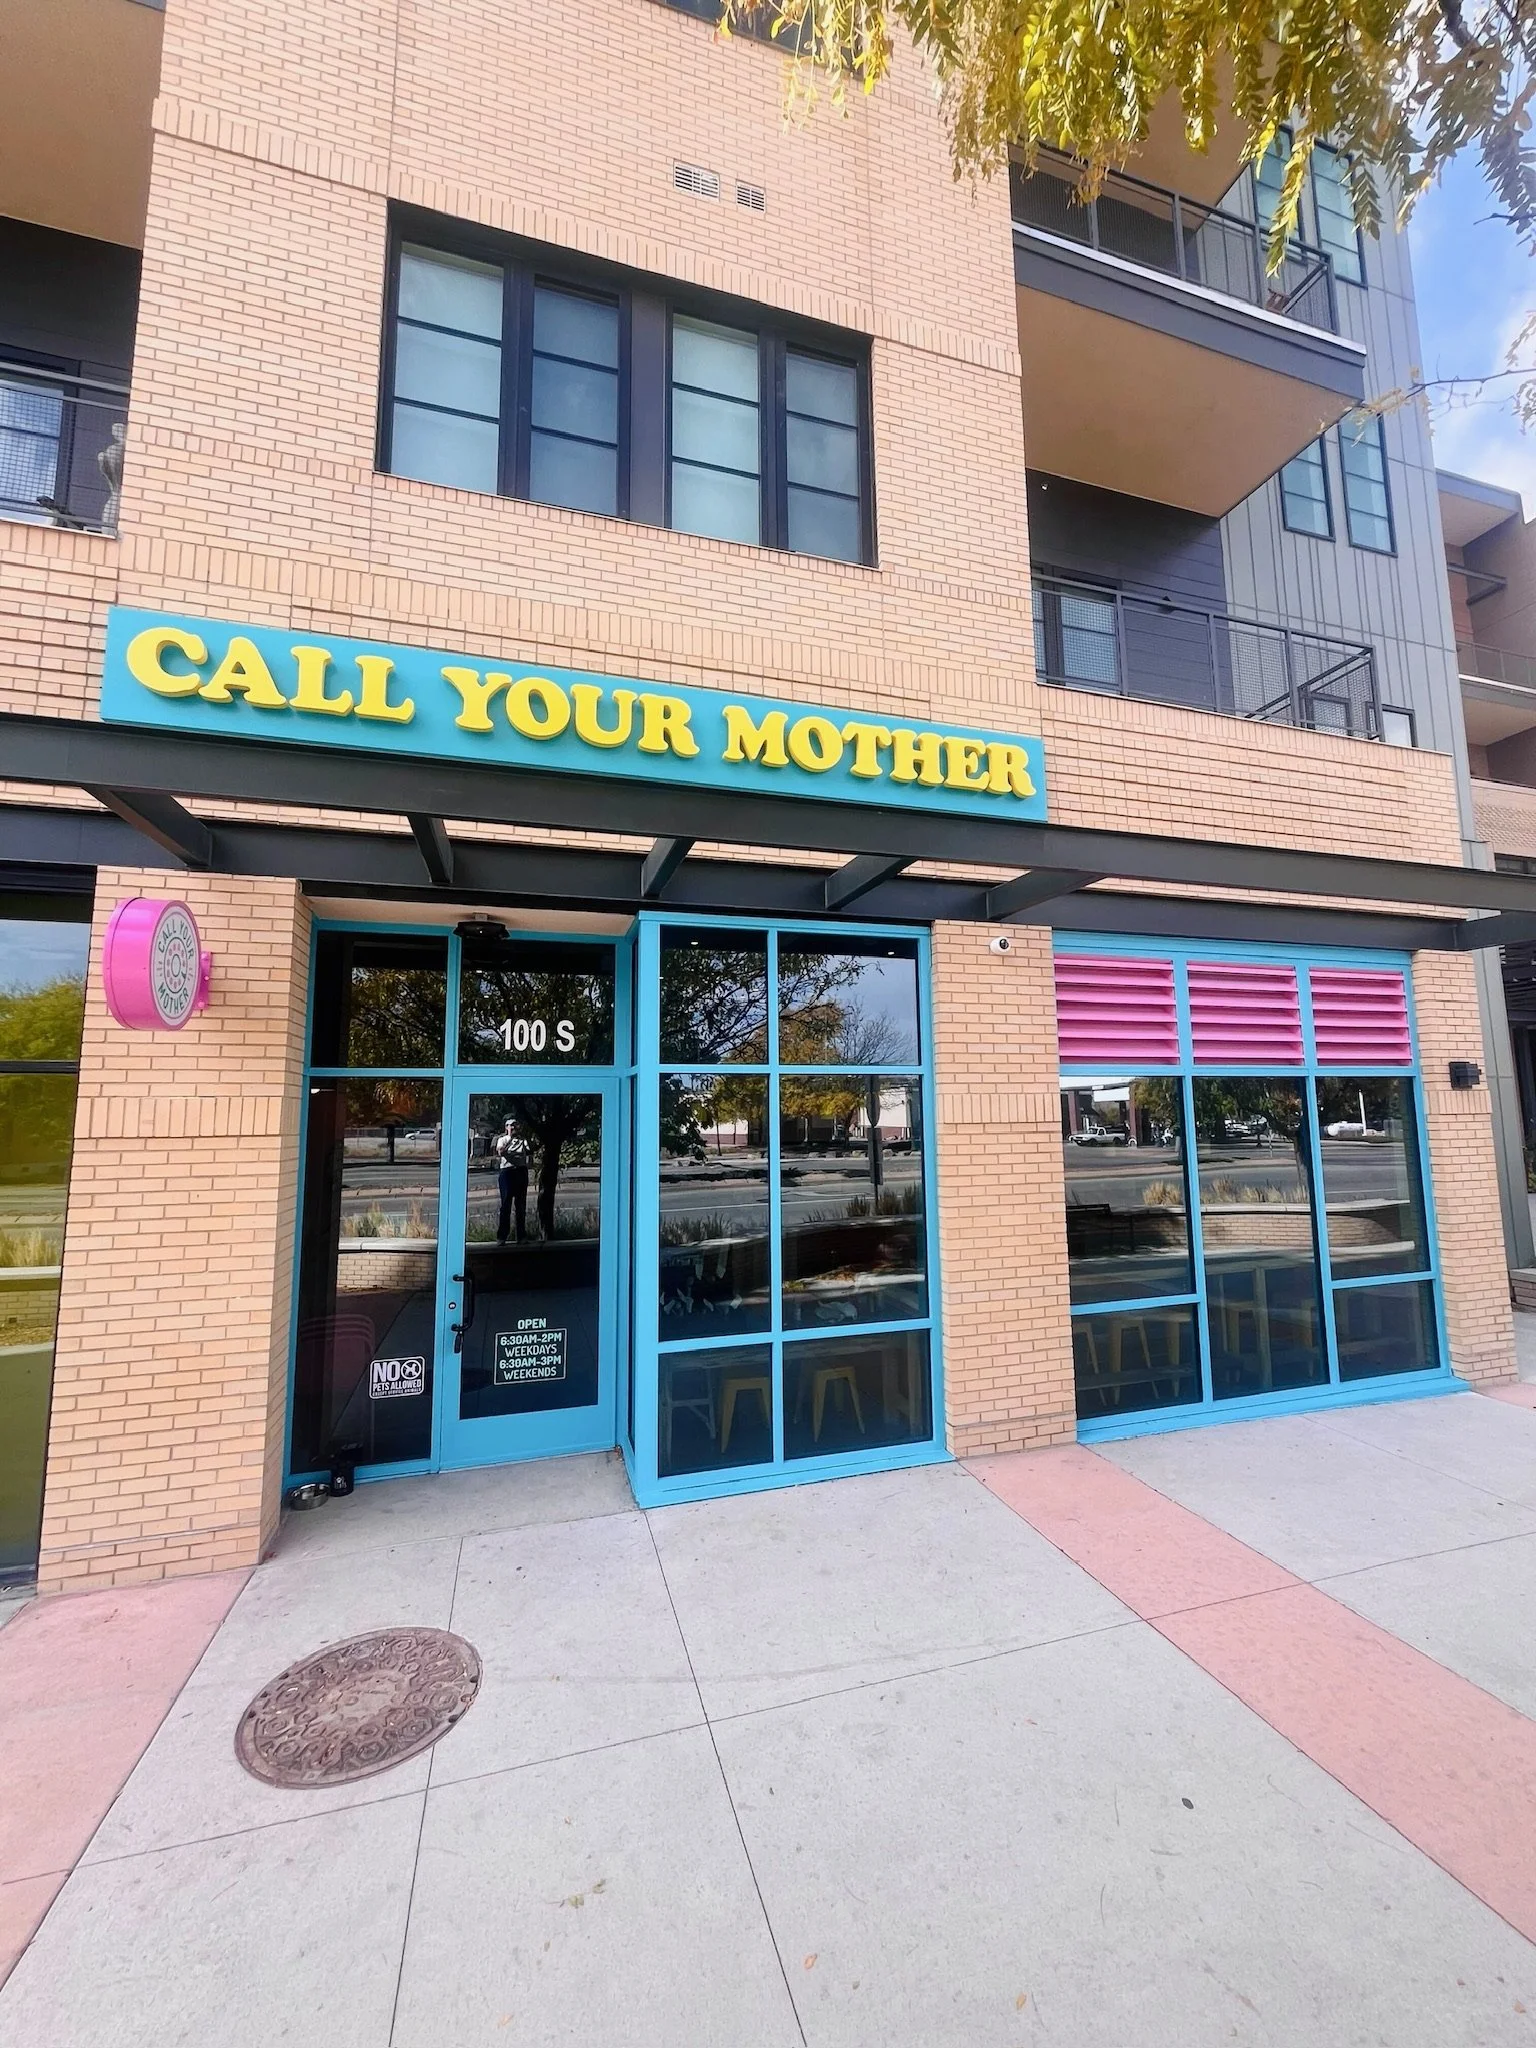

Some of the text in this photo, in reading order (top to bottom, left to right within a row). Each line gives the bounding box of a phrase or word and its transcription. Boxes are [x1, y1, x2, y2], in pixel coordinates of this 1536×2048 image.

[126, 627, 1037, 799] CALL YOUR MOTHER
[158, 919, 195, 960] CALL YOUR
[158, 982, 189, 1014] MOTHER
[500, 1019, 575, 1052] 100 S
[517, 1318, 547, 1330] OPEN
[500, 1332, 562, 1346] 6:30AM-2PM
[504, 1343, 557, 1358] WEEKDAYS
[499, 1355, 562, 1369] 6:30AM-3PM
[373, 1361, 400, 1383] NO
[503, 1366, 557, 1380] WEEKENDS
[373, 1382, 390, 1392] PETS
[390, 1379, 422, 1390] ALLOWED
